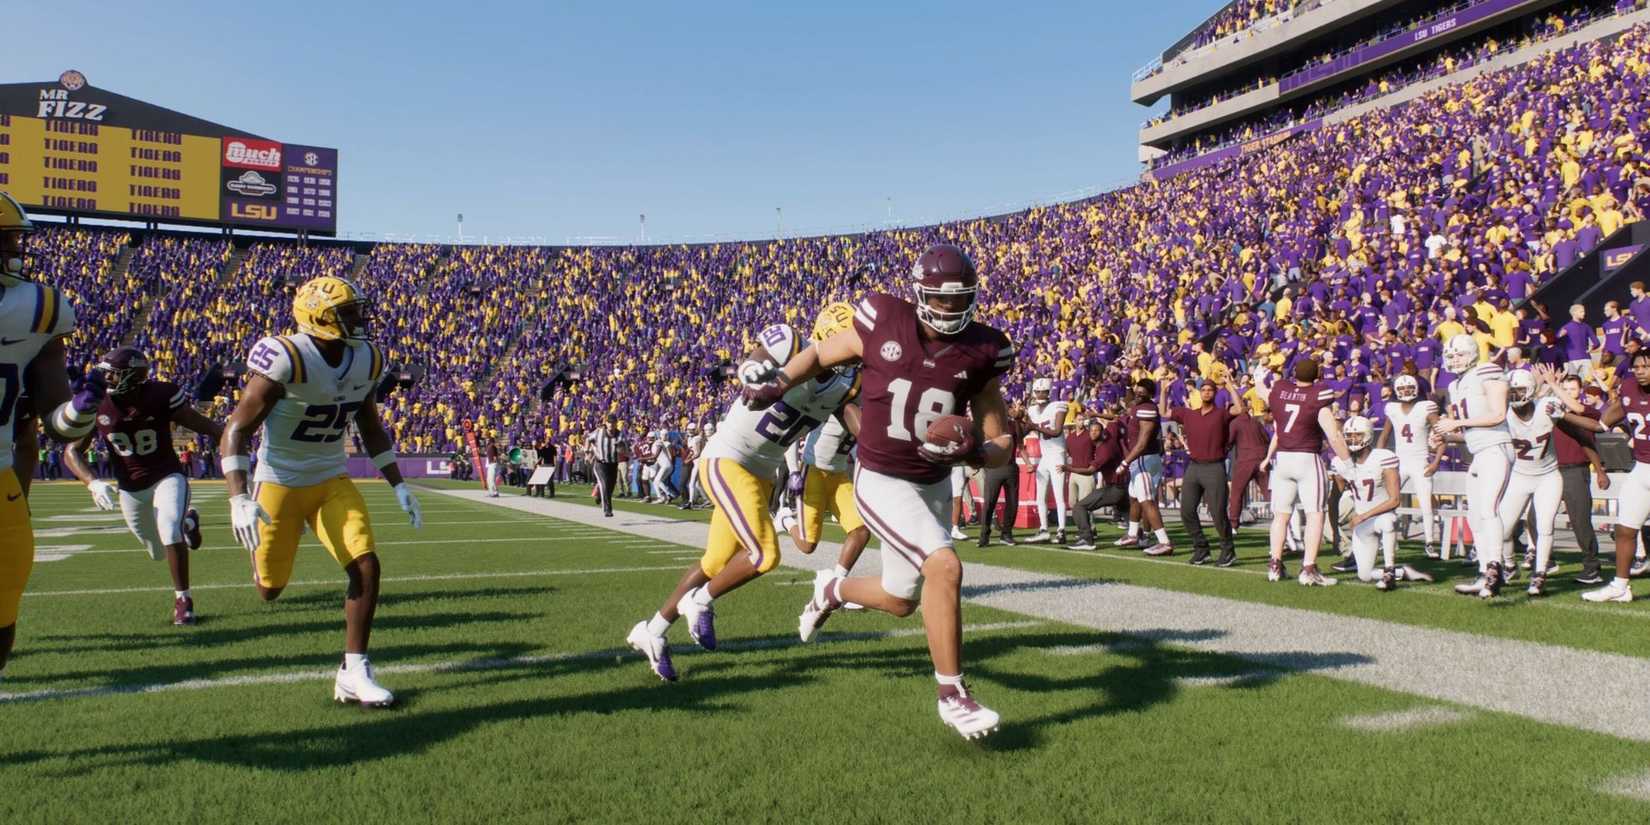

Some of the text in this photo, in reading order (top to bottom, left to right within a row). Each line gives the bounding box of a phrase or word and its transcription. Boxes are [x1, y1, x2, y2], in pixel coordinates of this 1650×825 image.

[1414, 29, 1428, 41] LSU
[39, 89, 69, 101] MR
[36, 101, 108, 121] FIZZ
[231, 202, 278, 221] LSU
[1606, 251, 1634, 267] LS
[248, 342, 281, 372] 25
[886, 377, 956, 443] 18
[1283, 403, 1300, 433] 7
[289, 400, 364, 443] 25
[1627, 412, 1650, 440] 2
[1401, 423, 1414, 443] 4
[1511, 431, 1551, 461] 27
[426, 460, 451, 475] LS
